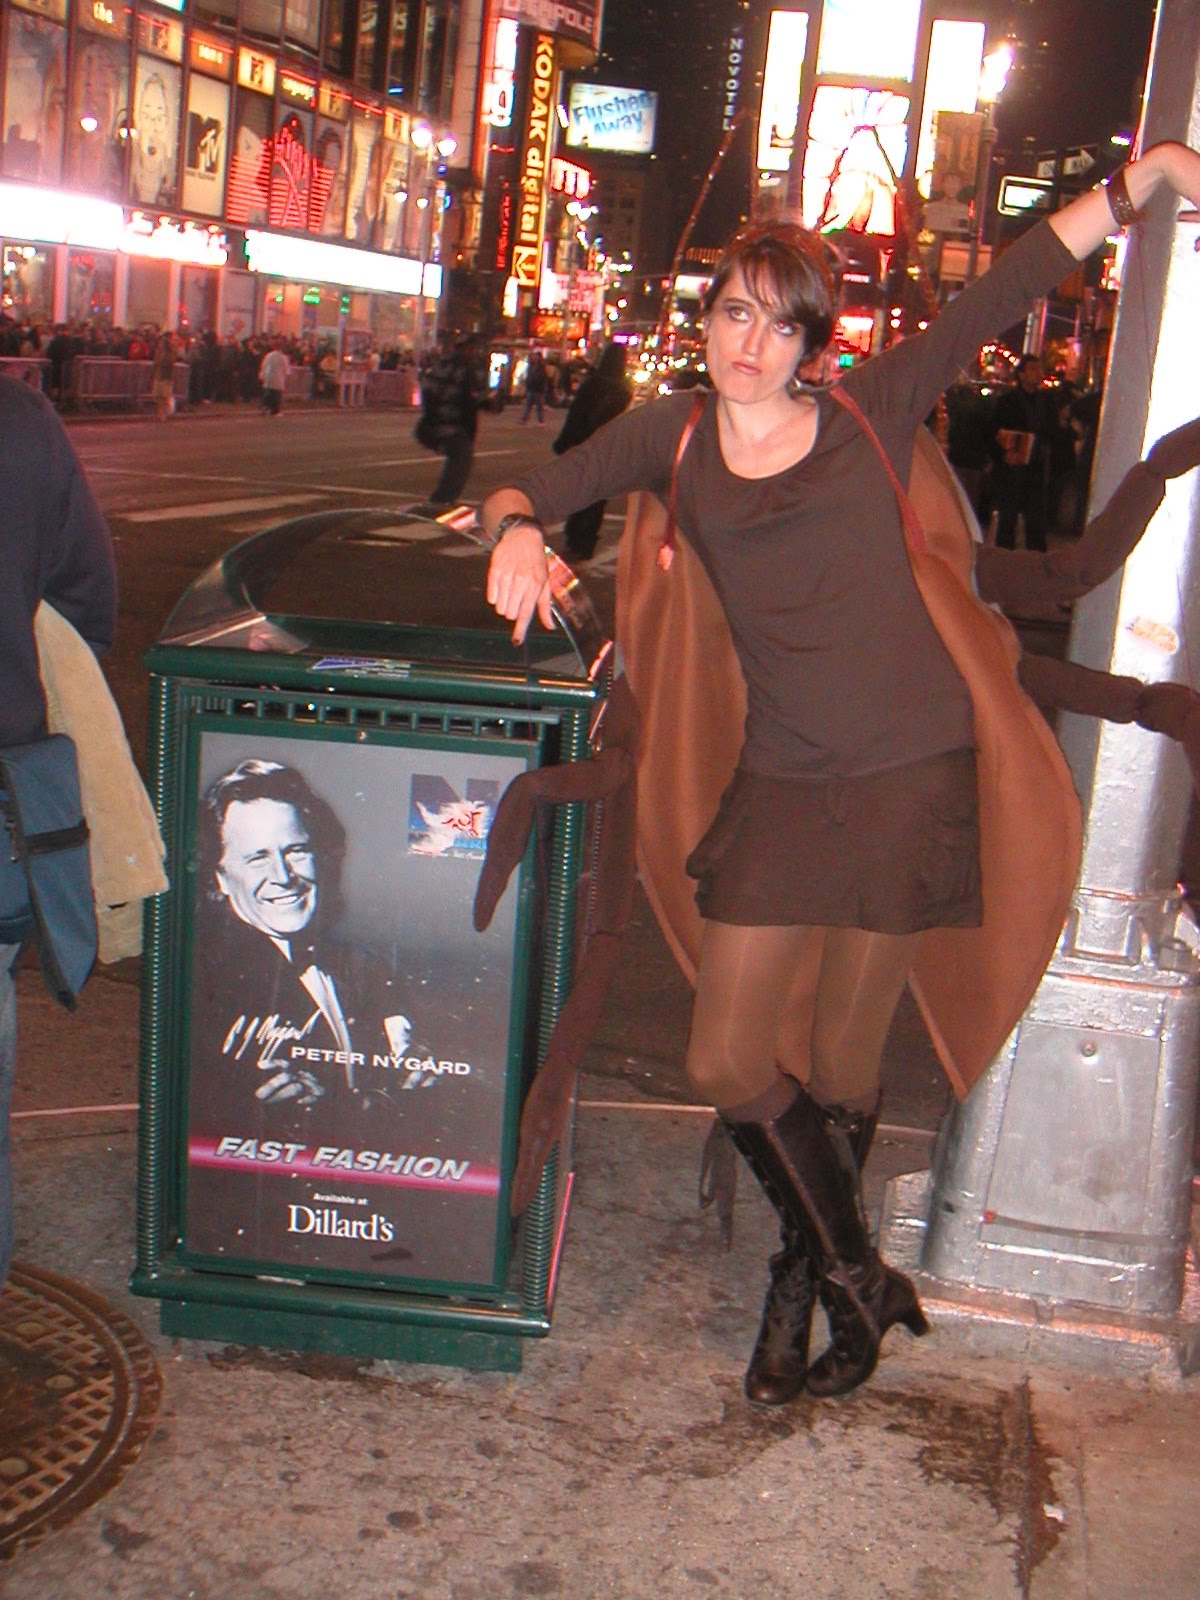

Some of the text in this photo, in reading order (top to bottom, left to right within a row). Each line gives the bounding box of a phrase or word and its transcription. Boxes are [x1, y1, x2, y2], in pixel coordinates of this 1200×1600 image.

[529, 34, 554, 142] KODAK
[722, 38, 744, 131] NOVOTEL
[521, 147, 545, 242] digital
[290, 1046, 365, 1066] PETER
[215, 1137, 470, 1181] FAST FASHION
[287, 1204, 394, 1242] Dillard's
